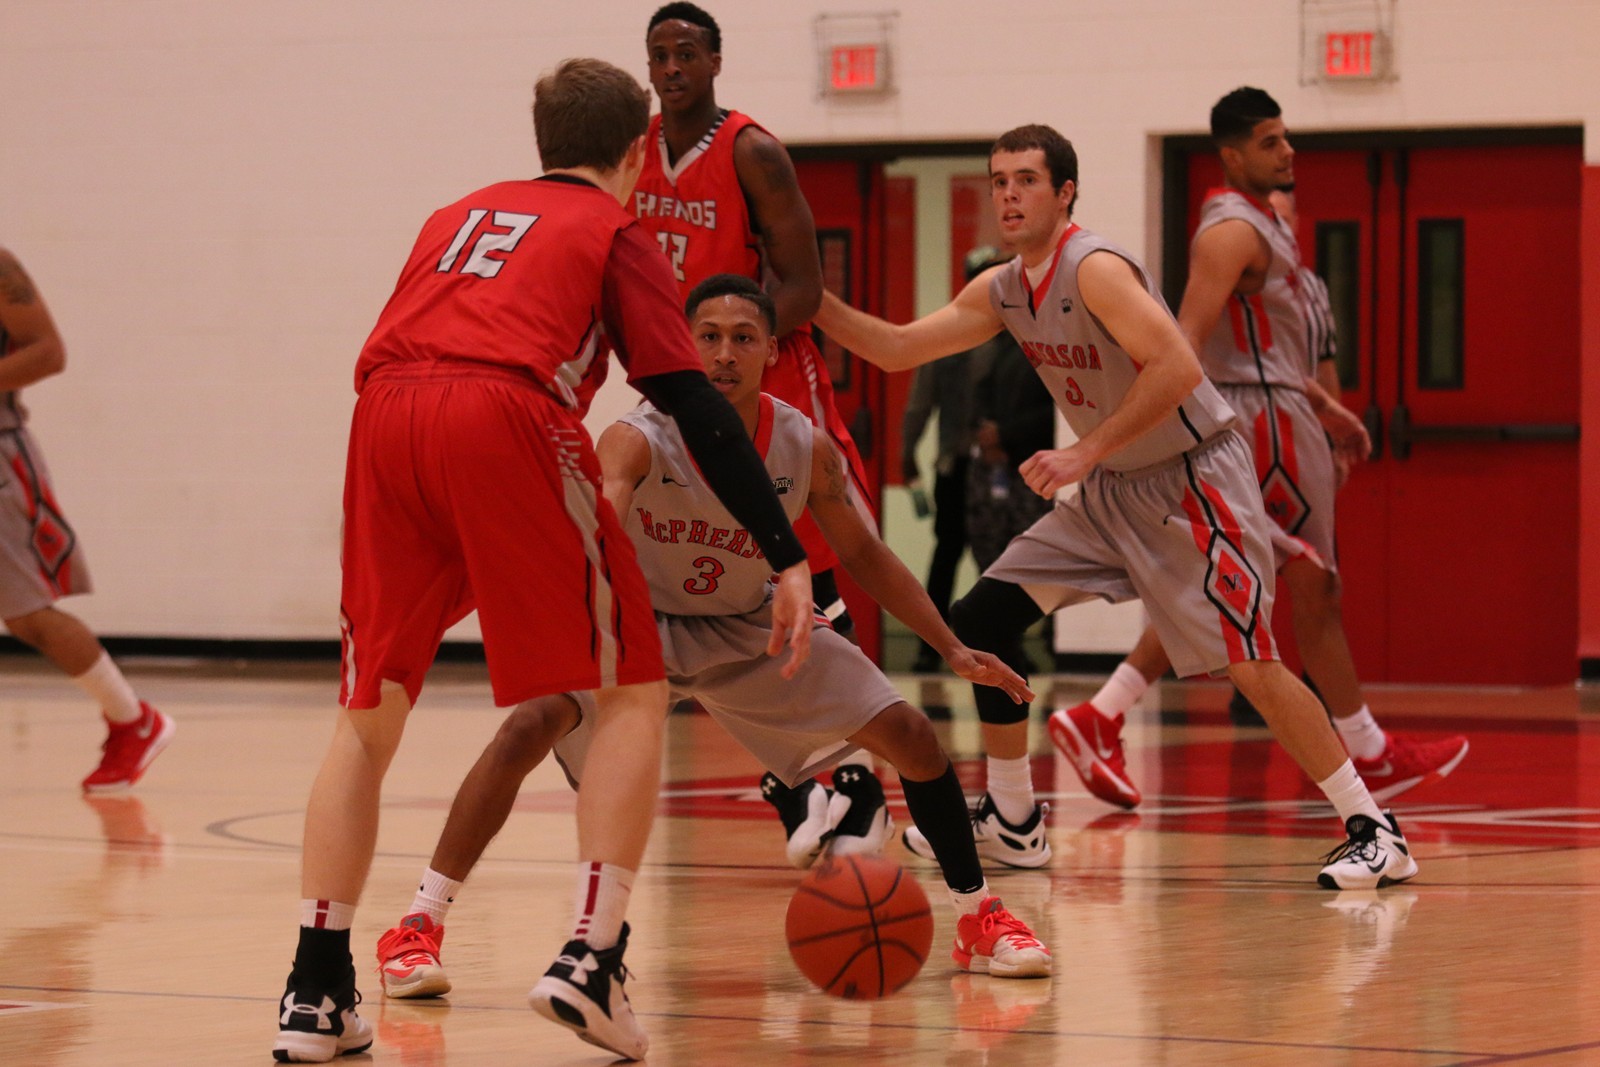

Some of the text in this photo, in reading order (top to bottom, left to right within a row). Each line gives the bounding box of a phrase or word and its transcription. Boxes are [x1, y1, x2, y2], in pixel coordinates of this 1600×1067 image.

[832, 46, 876, 89] EXIT
[1326, 32, 1374, 76] EXIT
[436, 208, 541, 279] 12
[636, 507, 766, 560] McPHERS
[683, 555, 726, 595] 3
